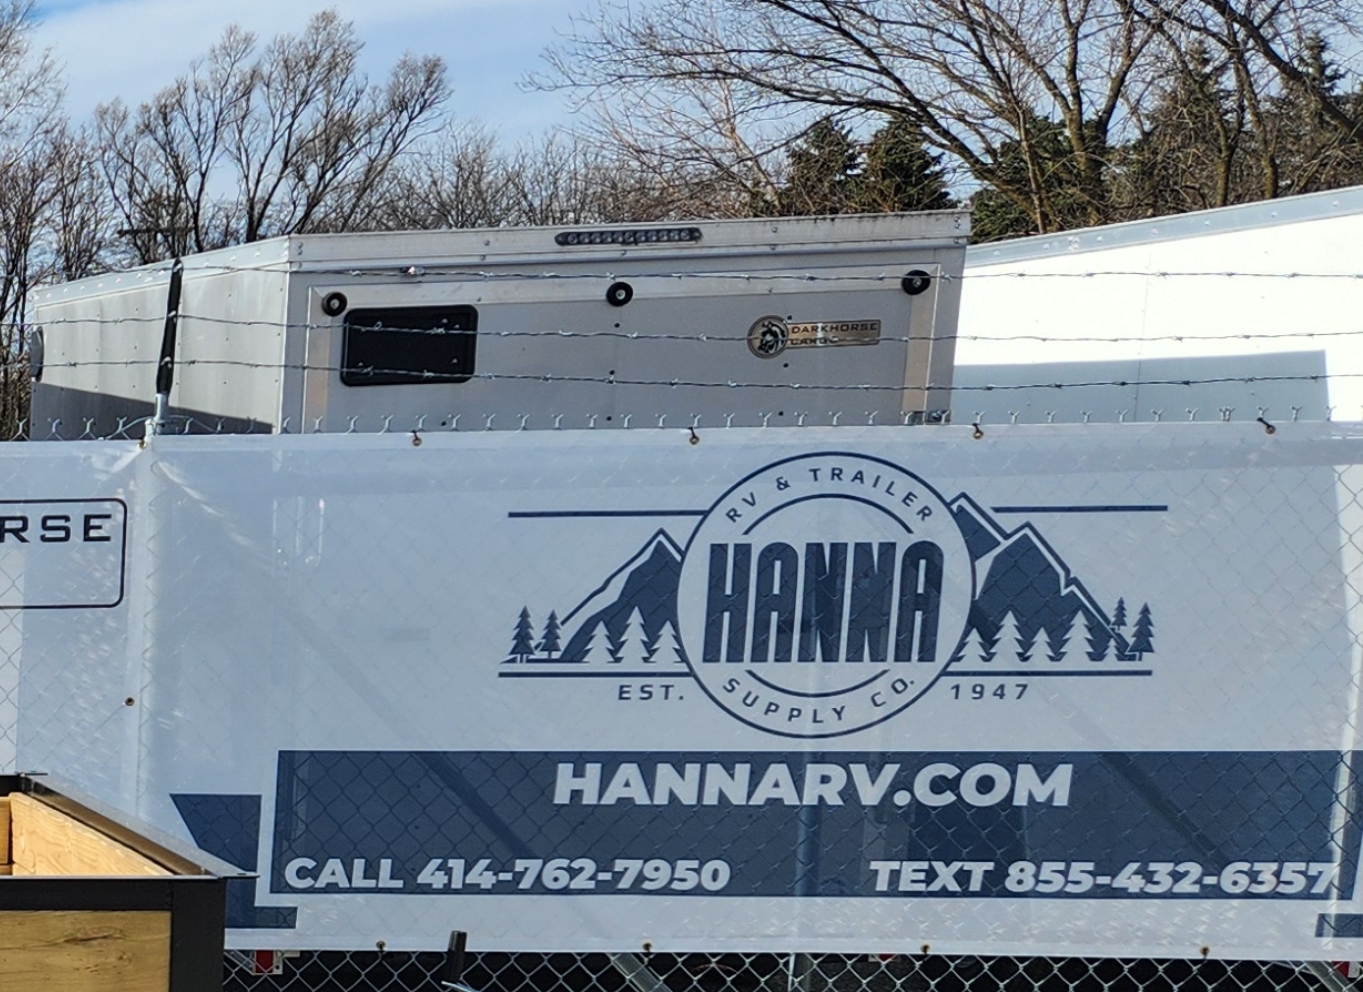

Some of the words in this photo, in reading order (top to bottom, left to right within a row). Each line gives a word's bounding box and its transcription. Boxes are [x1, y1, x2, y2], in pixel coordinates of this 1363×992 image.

[791, 322, 879, 335] DARKHORSE
[725, 492, 758, 523] RV
[775, 476, 791, 491] &
[809, 467, 933, 522] TRAILER
[702, 541, 944, 663] HANNA
[617, 684, 685, 701] EST.
[722, 676, 847, 724] SUPPLY
[871, 677, 915, 708] CO.
[950, 684, 1029, 700] 1947
[553, 762, 1074, 807] HANNARV.COM
[284, 857, 404, 890] CALL
[416, 858, 731, 892] 414-762-7950
[869, 861, 995, 892] TEXT
[1004, 860, 1340, 894] 855-432-6357
